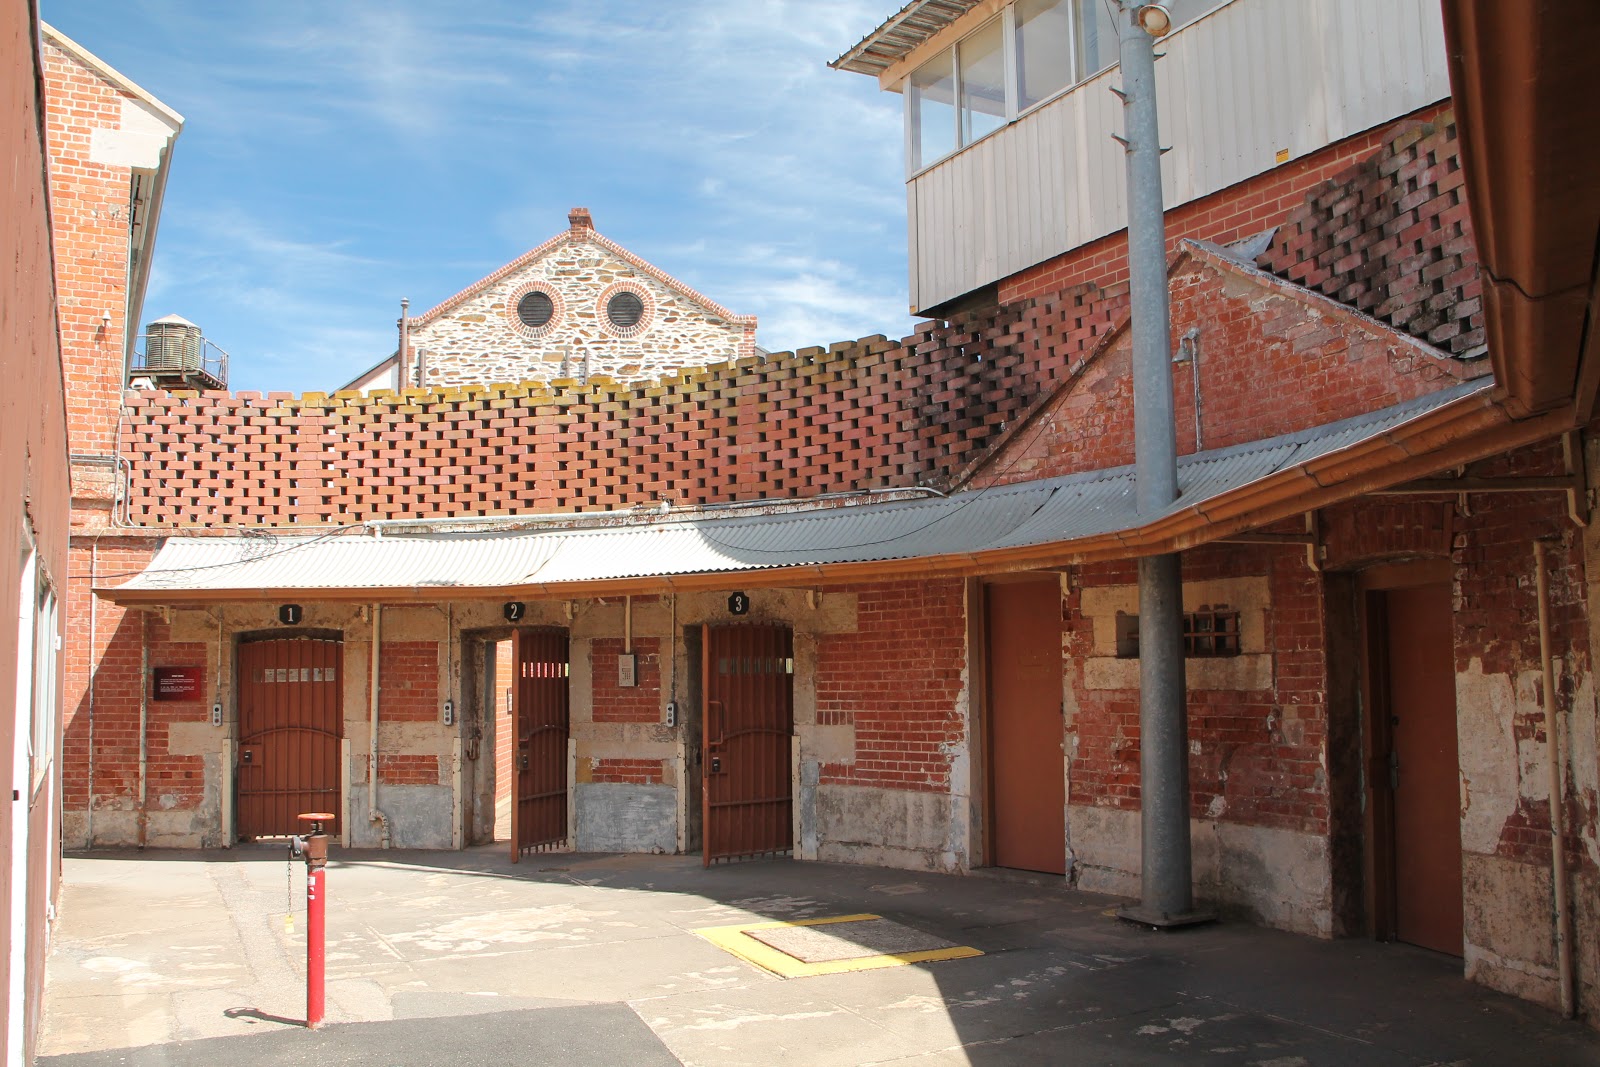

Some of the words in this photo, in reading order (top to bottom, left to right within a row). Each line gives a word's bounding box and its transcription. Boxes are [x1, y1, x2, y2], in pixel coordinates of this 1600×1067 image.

[510, 603, 518, 619] 2
[735, 596, 742, 611] 3
[287, 607, 293, 621] 1
